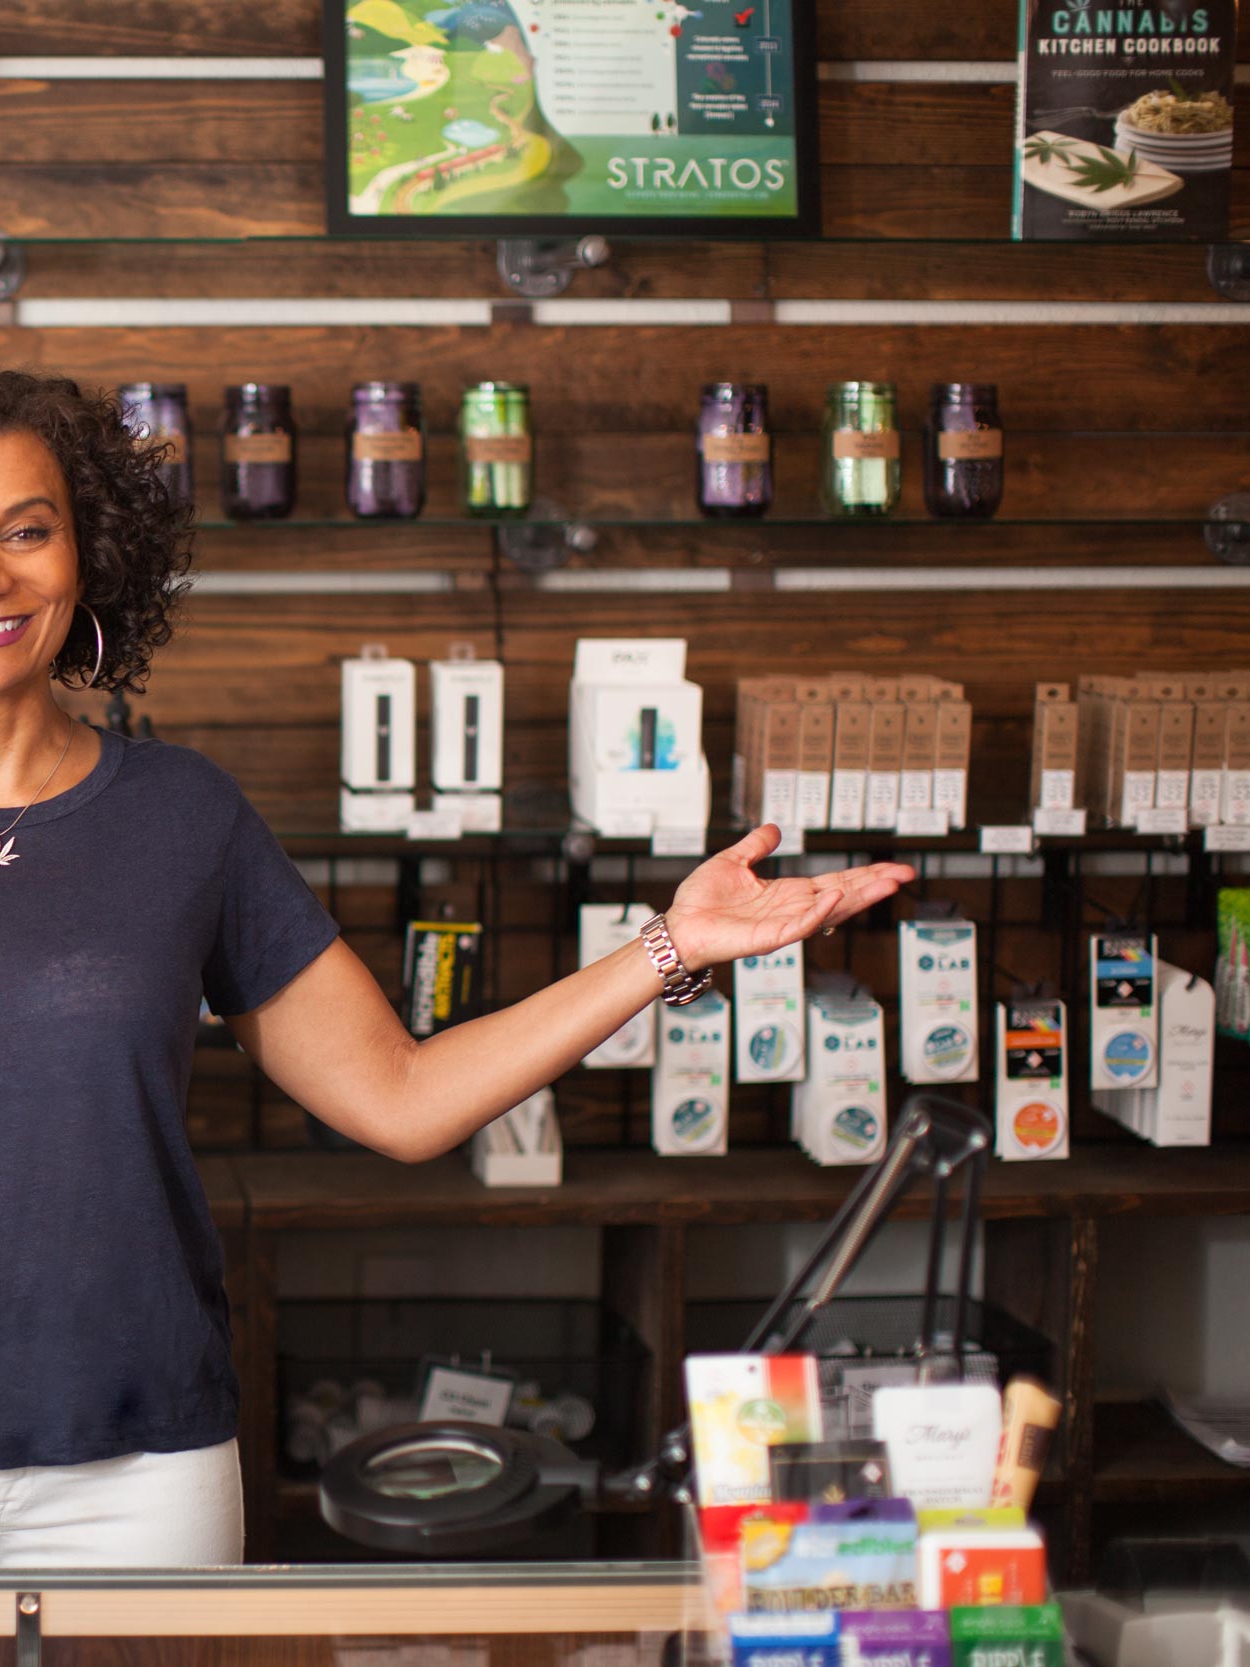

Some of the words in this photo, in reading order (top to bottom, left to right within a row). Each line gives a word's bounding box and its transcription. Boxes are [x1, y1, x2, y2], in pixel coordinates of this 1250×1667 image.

[1038, 38, 1117, 55] KITCHEN
[1122, 37, 1222, 54] COOKBOOK
[607, 156, 785, 190] STRATOS
[867, 1582, 918, 1604] BAR
